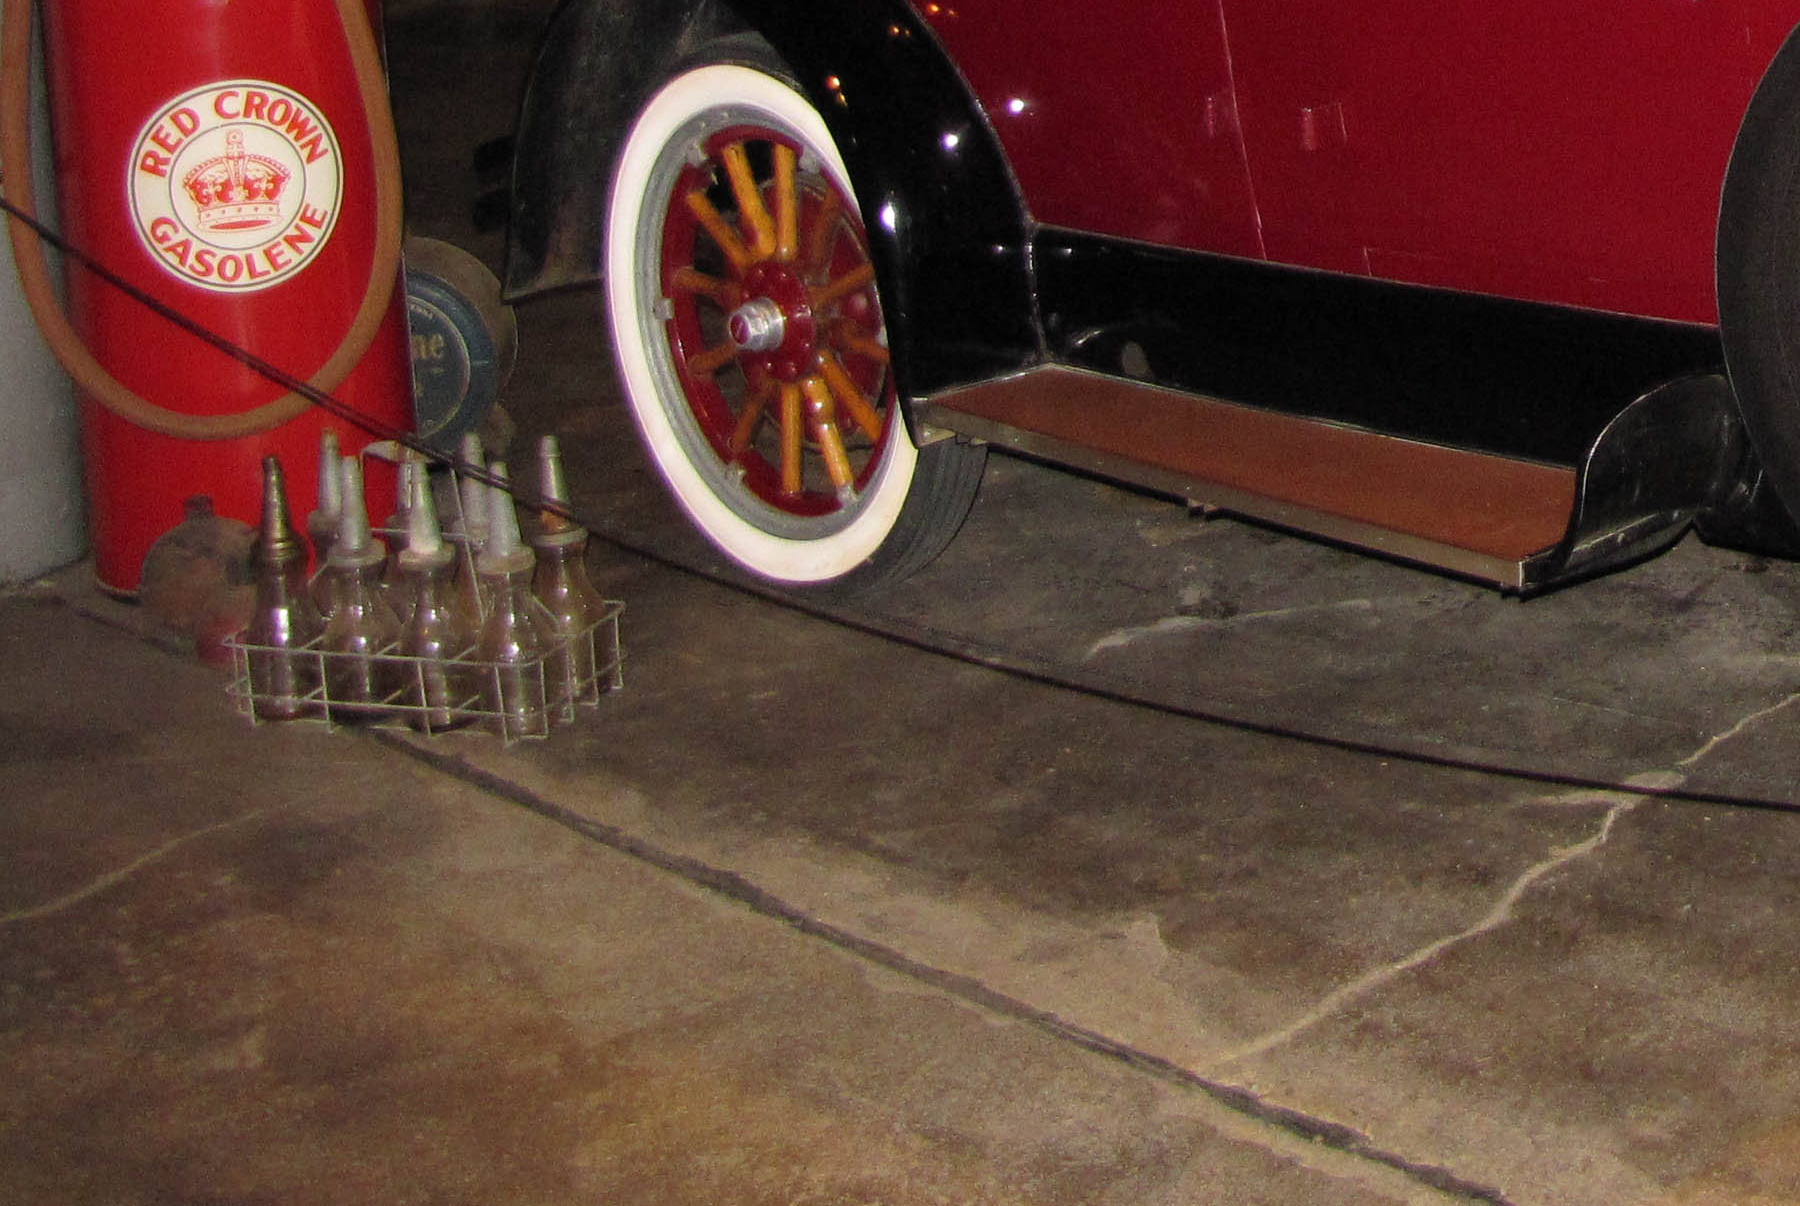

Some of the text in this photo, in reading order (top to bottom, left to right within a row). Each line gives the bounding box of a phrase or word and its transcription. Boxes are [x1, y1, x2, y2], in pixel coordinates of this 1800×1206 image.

[140, 91, 328, 177] RED CROWN
[150, 203, 328, 282] GASOLENE
